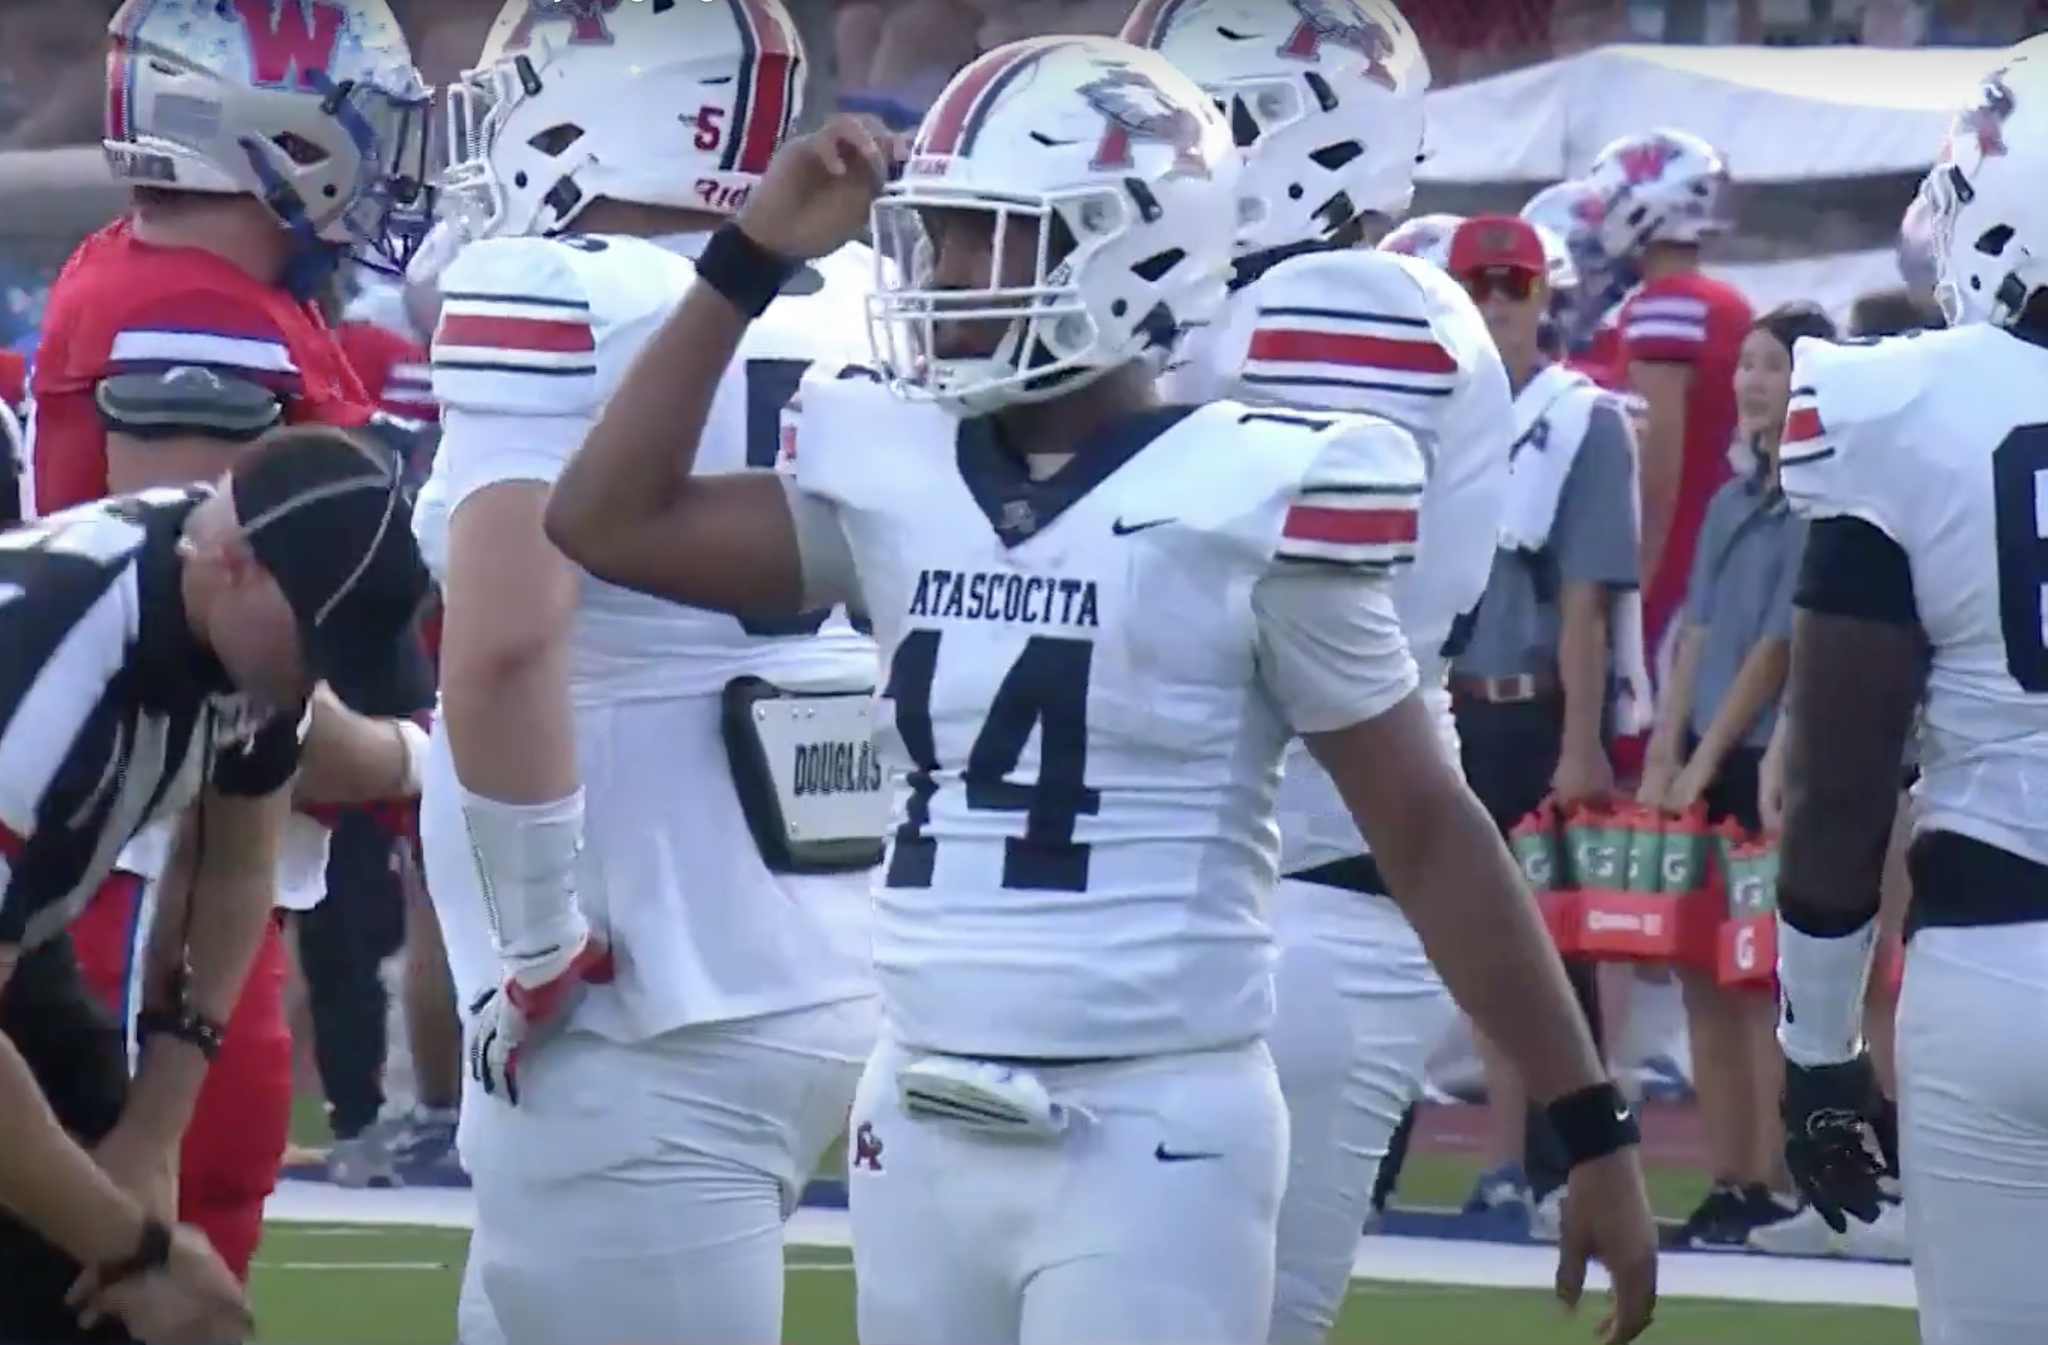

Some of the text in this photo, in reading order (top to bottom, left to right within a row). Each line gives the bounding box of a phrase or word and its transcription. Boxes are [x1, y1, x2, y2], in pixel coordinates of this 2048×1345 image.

[231, 0, 347, 94] W
[694, 106, 725, 151] 5
[909, 569, 1099, 626] ATASCOCITA
[794, 741, 882, 796] DOUGLAS
[883, 628, 1100, 892] 14
[1525, 853, 1551, 885] G
[1663, 852, 1688, 883] G
[1735, 926, 1756, 971] G
